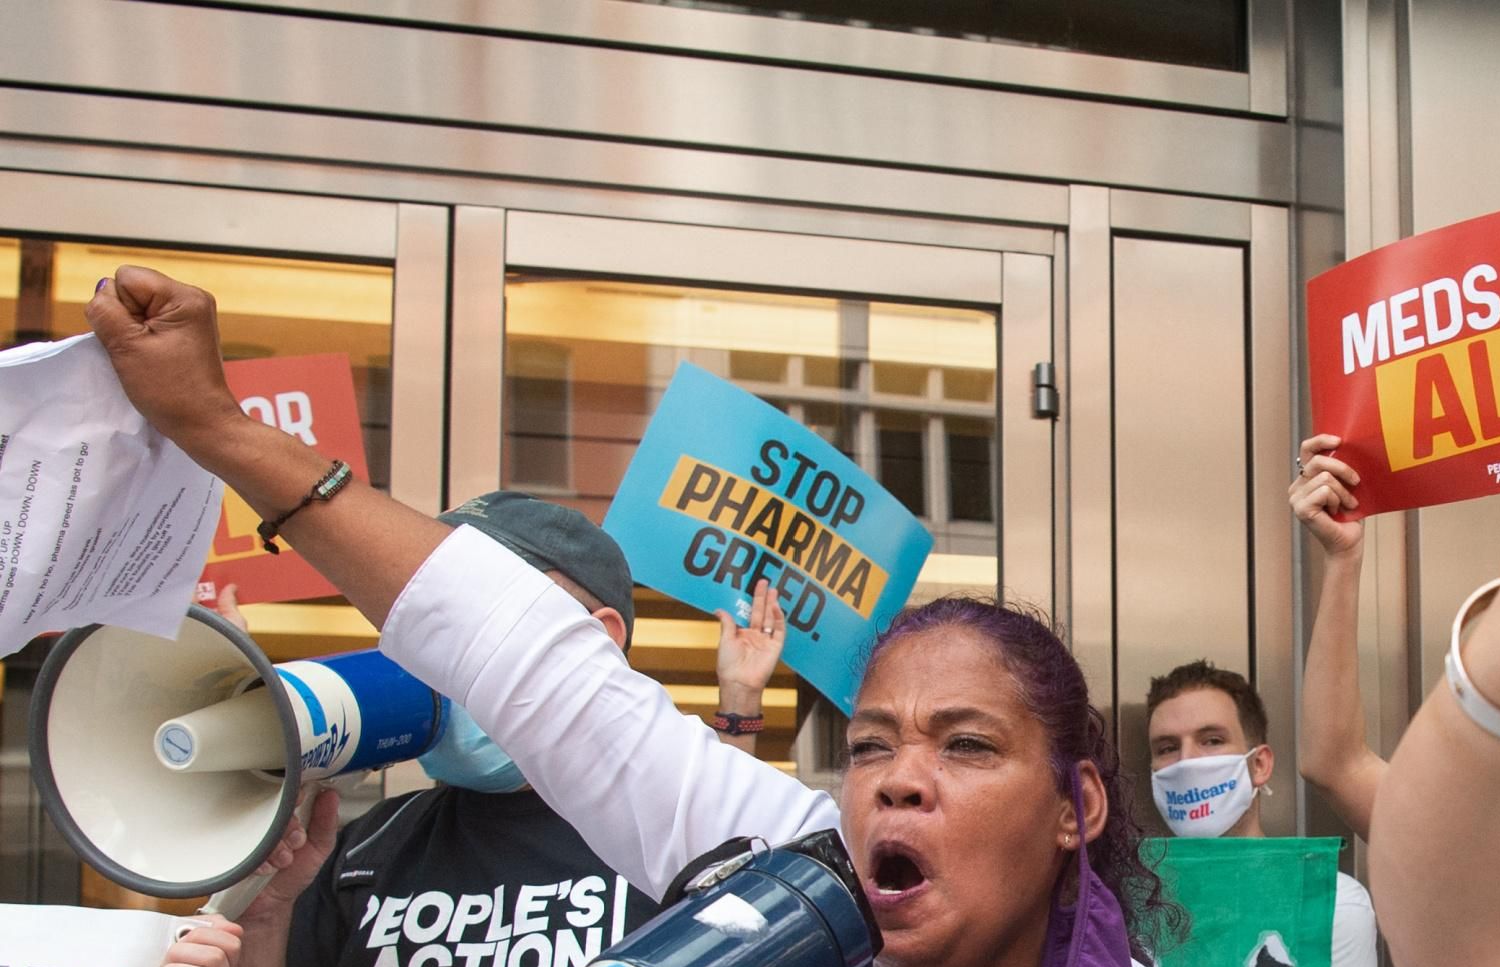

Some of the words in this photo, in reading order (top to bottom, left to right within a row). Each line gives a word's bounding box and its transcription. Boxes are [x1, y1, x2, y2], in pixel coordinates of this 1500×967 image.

[26, 459, 42, 492] DOWN
[73, 468, 82, 483] got
[751, 439, 865, 528] STOP
[67, 484, 78, 501] has
[62, 502, 74, 528] greed
[676, 464, 872, 610] PHARMA
[1165, 779, 1237, 806] Medicare
[1168, 806, 1187, 821] for
[1189, 802, 1214, 820] all.
